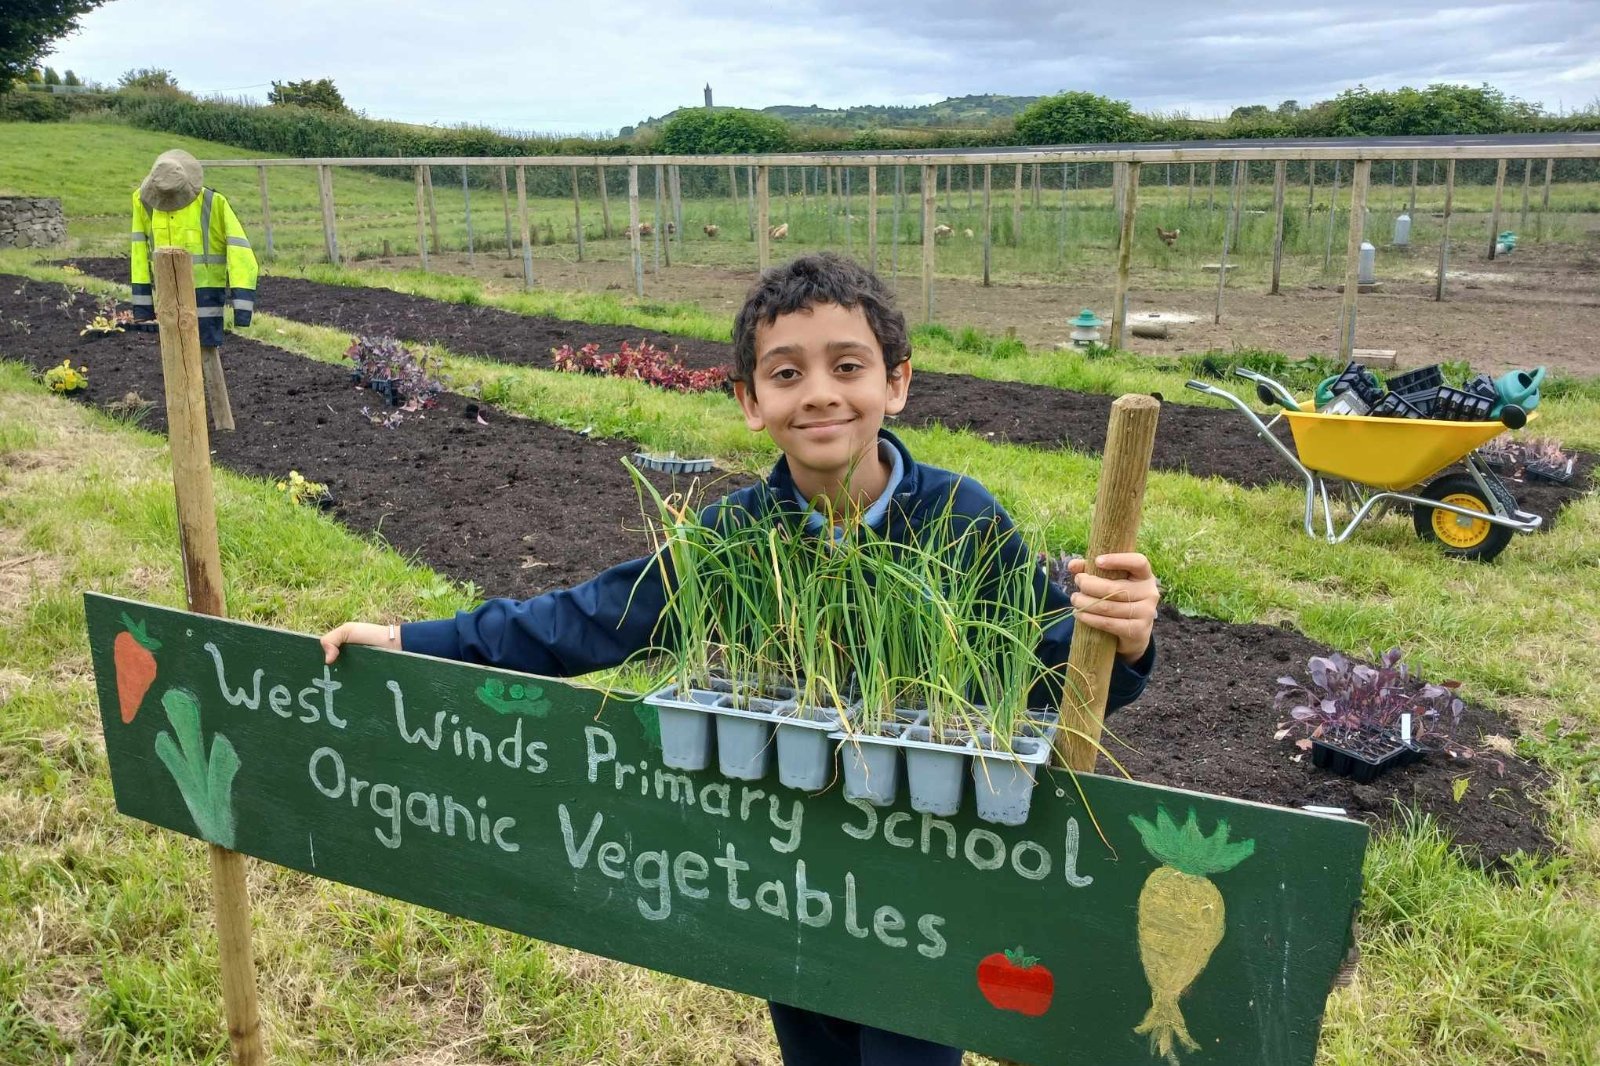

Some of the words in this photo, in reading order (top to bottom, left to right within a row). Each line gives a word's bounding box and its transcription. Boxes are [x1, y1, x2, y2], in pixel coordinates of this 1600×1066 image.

[204, 641, 348, 729] West
[386, 680, 549, 774] Winds
[584, 726, 803, 854] Primary
[308, 746, 520, 851] Organic
[557, 804, 948, 959] Vegetables
